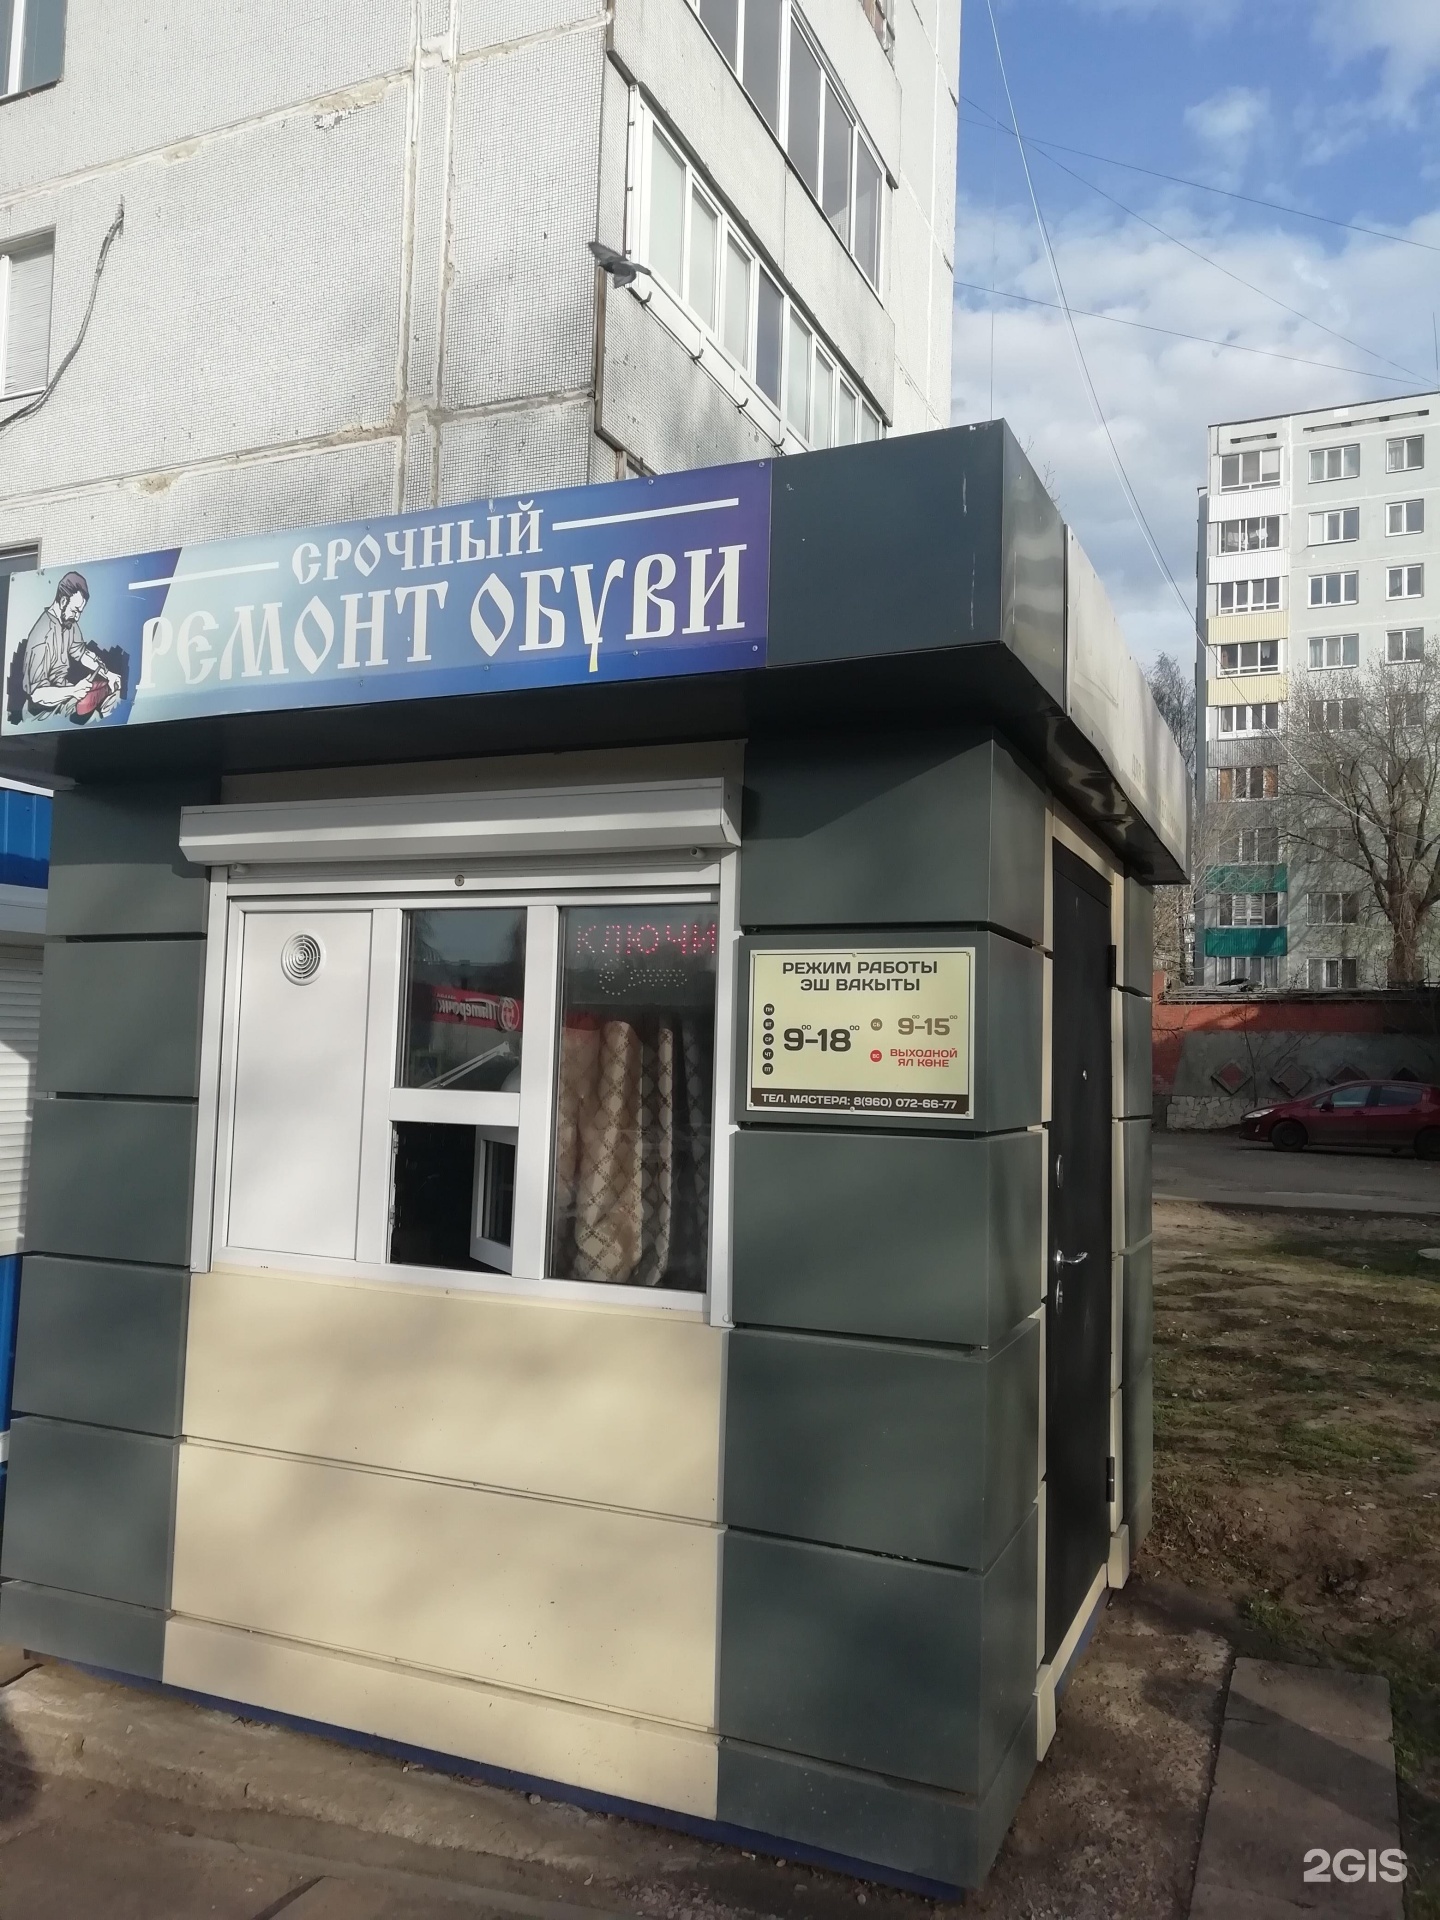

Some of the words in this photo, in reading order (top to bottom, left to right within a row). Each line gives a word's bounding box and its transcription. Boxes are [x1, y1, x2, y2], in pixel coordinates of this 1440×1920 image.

[292, 499, 544, 585] СРОЧНЫЙ
[135, 580, 449, 690] РЕМОНТ
[470, 543, 748, 673] ОБУВИ
[576, 923, 716, 955] КЛЮЧИ
[782, 961, 851, 974] РЕЖИМ
[857, 960, 938, 974] РАБОТЫ
[800, 978, 830, 991] ЭШ
[835, 978, 920, 991] ВАКЫТЫ
[890, 1048, 958, 1058] ВЫХОДНОЙ
[897, 1058, 914, 1067] ЯЛ
[761, 1093, 787, 1104] ТЕЛ.
[790, 1095, 851, 1106] МАСТЕРА:
[853, 1096, 892, 1108] 8(960)
[895, 1098, 958, 1110] 072-66-77
